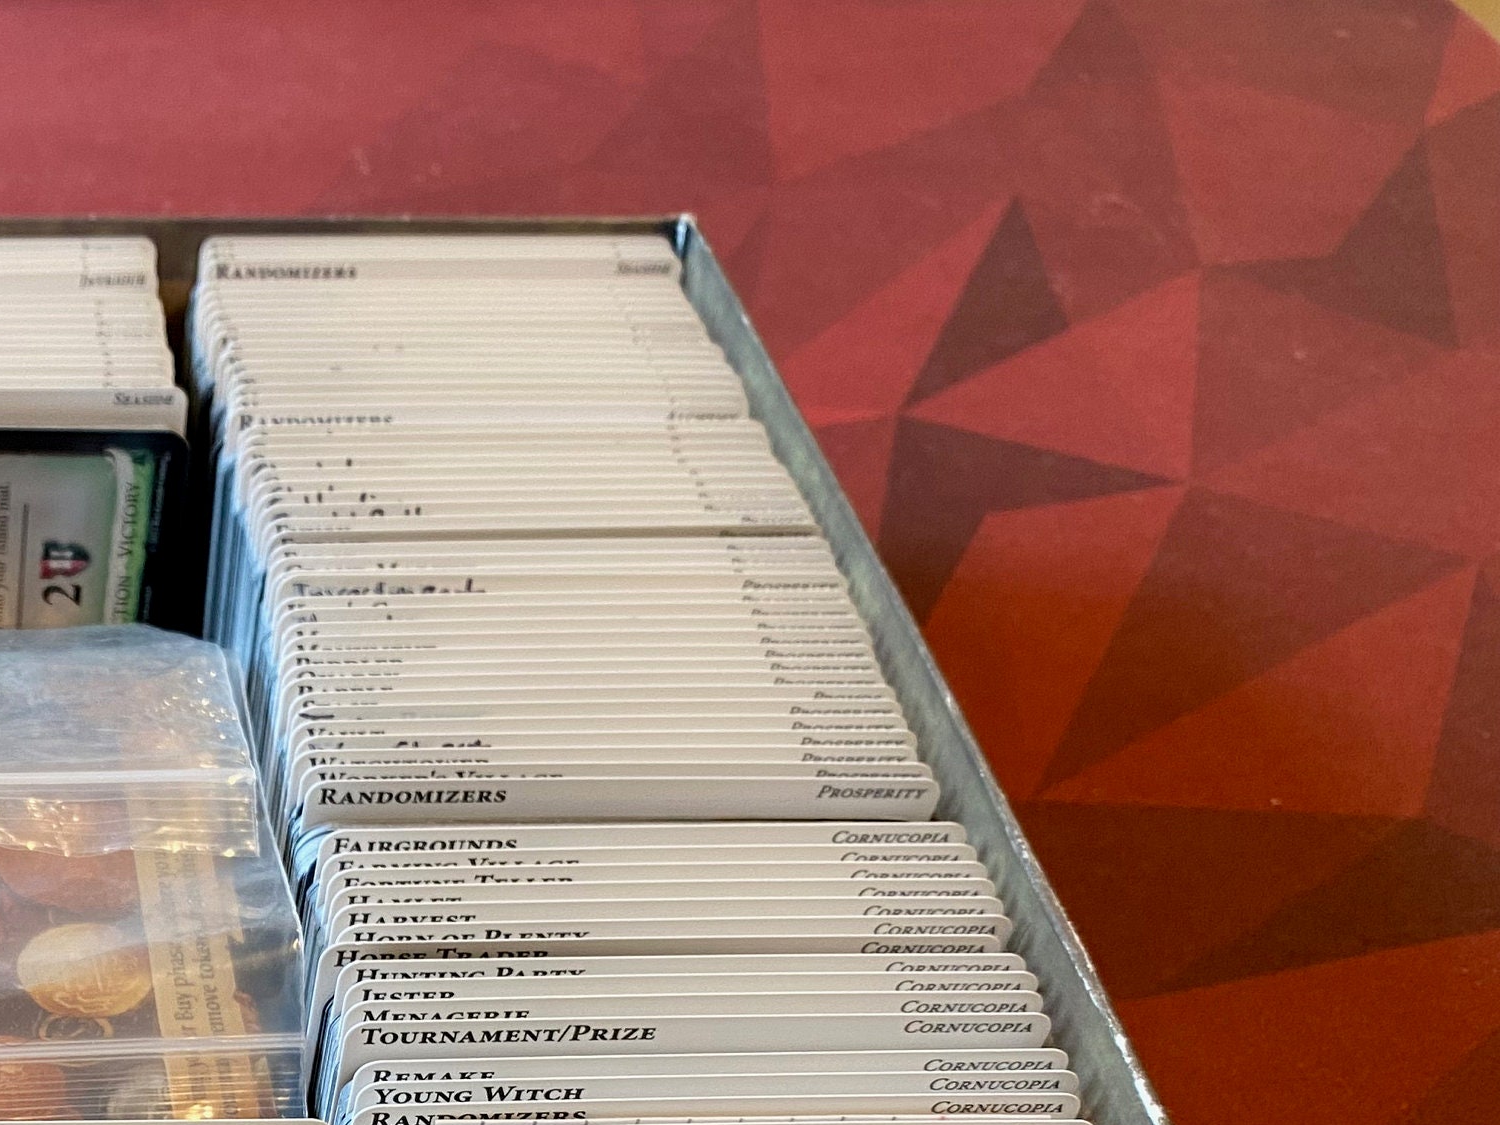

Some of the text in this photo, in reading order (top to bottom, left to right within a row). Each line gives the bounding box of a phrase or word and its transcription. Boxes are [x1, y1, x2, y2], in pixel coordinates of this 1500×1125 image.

[216, 264, 356, 280] RANDOMIZERS
[117, 482, 139, 558] VICTORY
[42, 585, 81, 605] 2
[318, 788, 507, 805] RANDOMIZERS
[816, 785, 928, 799] PROSPERITY
[831, 831, 949, 843] CORNUCOPIA
[874, 923, 995, 935] CORNUCOPIA
[861, 942, 985, 953] CORNUCOPIA
[175, 991, 198, 1020] Buy
[901, 1001, 1027, 1013] CORNUCOPIA
[904, 1020, 1032, 1034] CORNUCOPIA
[361, 1025, 656, 1045] TOURNAMENT/PRIZE
[924, 1059, 1053, 1072] CORNUCOPIA
[929, 1078, 1060, 1090] CORNUCOPIA
[374, 1086, 584, 1104] YOUNG WITCH
[931, 1102, 1063, 1114] CORNUCOPIA
